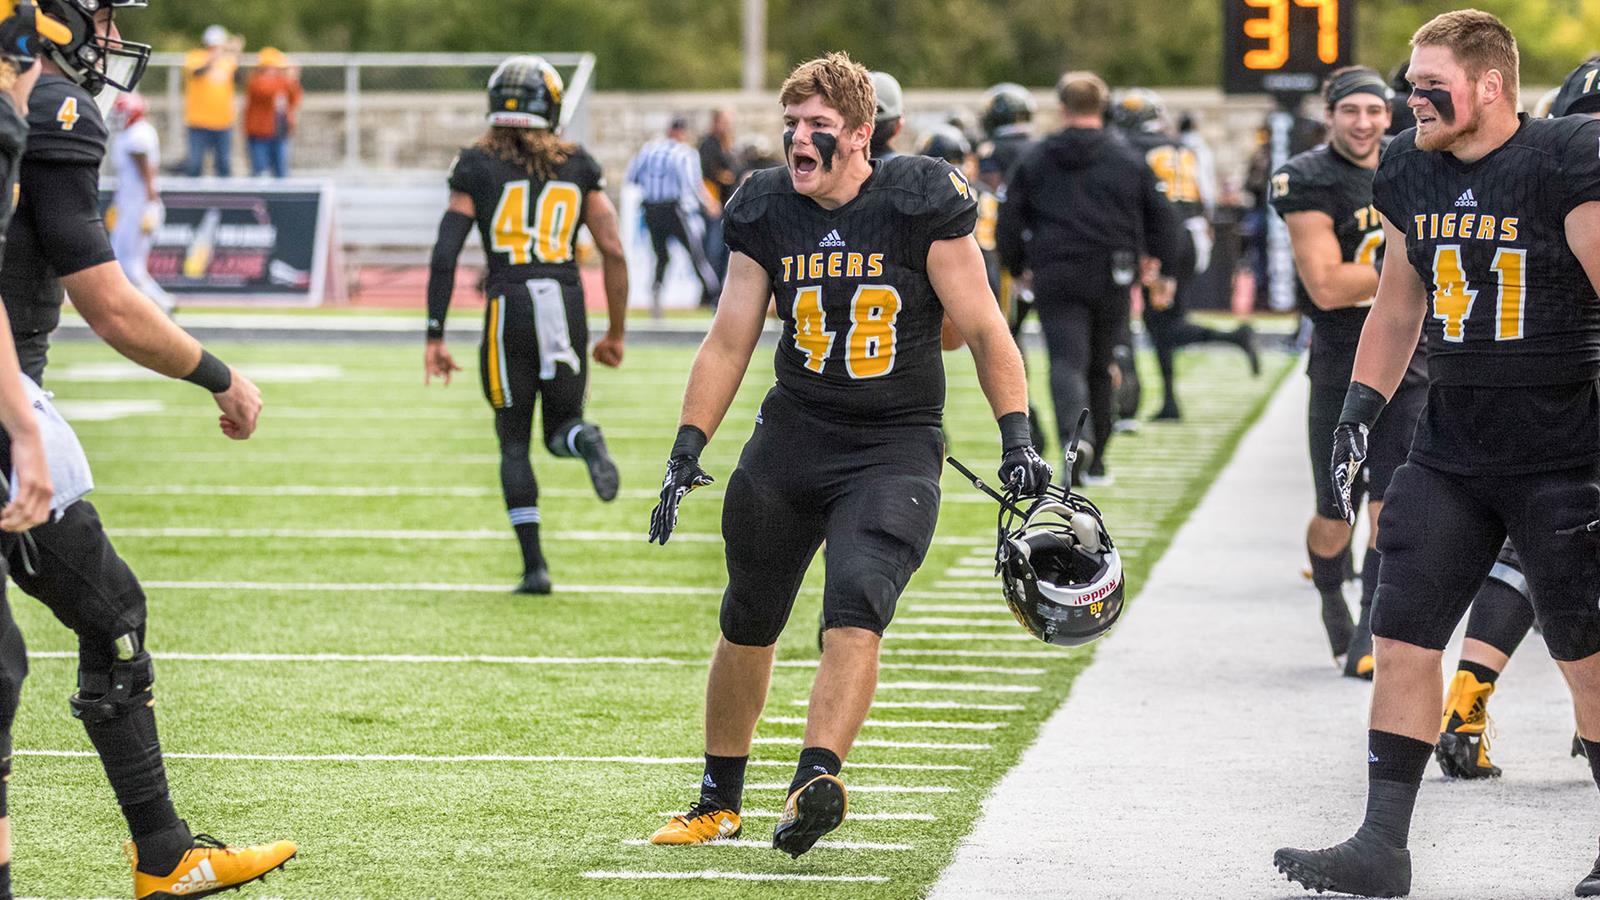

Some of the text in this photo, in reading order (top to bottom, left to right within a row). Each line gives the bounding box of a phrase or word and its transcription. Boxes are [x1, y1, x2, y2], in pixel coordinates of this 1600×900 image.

[1243, 0, 1338, 69] 37
[1582, 69, 1600, 95] 1
[56, 96, 80, 131] 4
[490, 180, 582, 265] 40
[1414, 213, 1519, 241] TIGERS
[781, 252, 884, 282] TIGERS
[1432, 245, 1527, 342] 41
[792, 284, 902, 379] 48
[1090, 601, 1104, 615] 48
